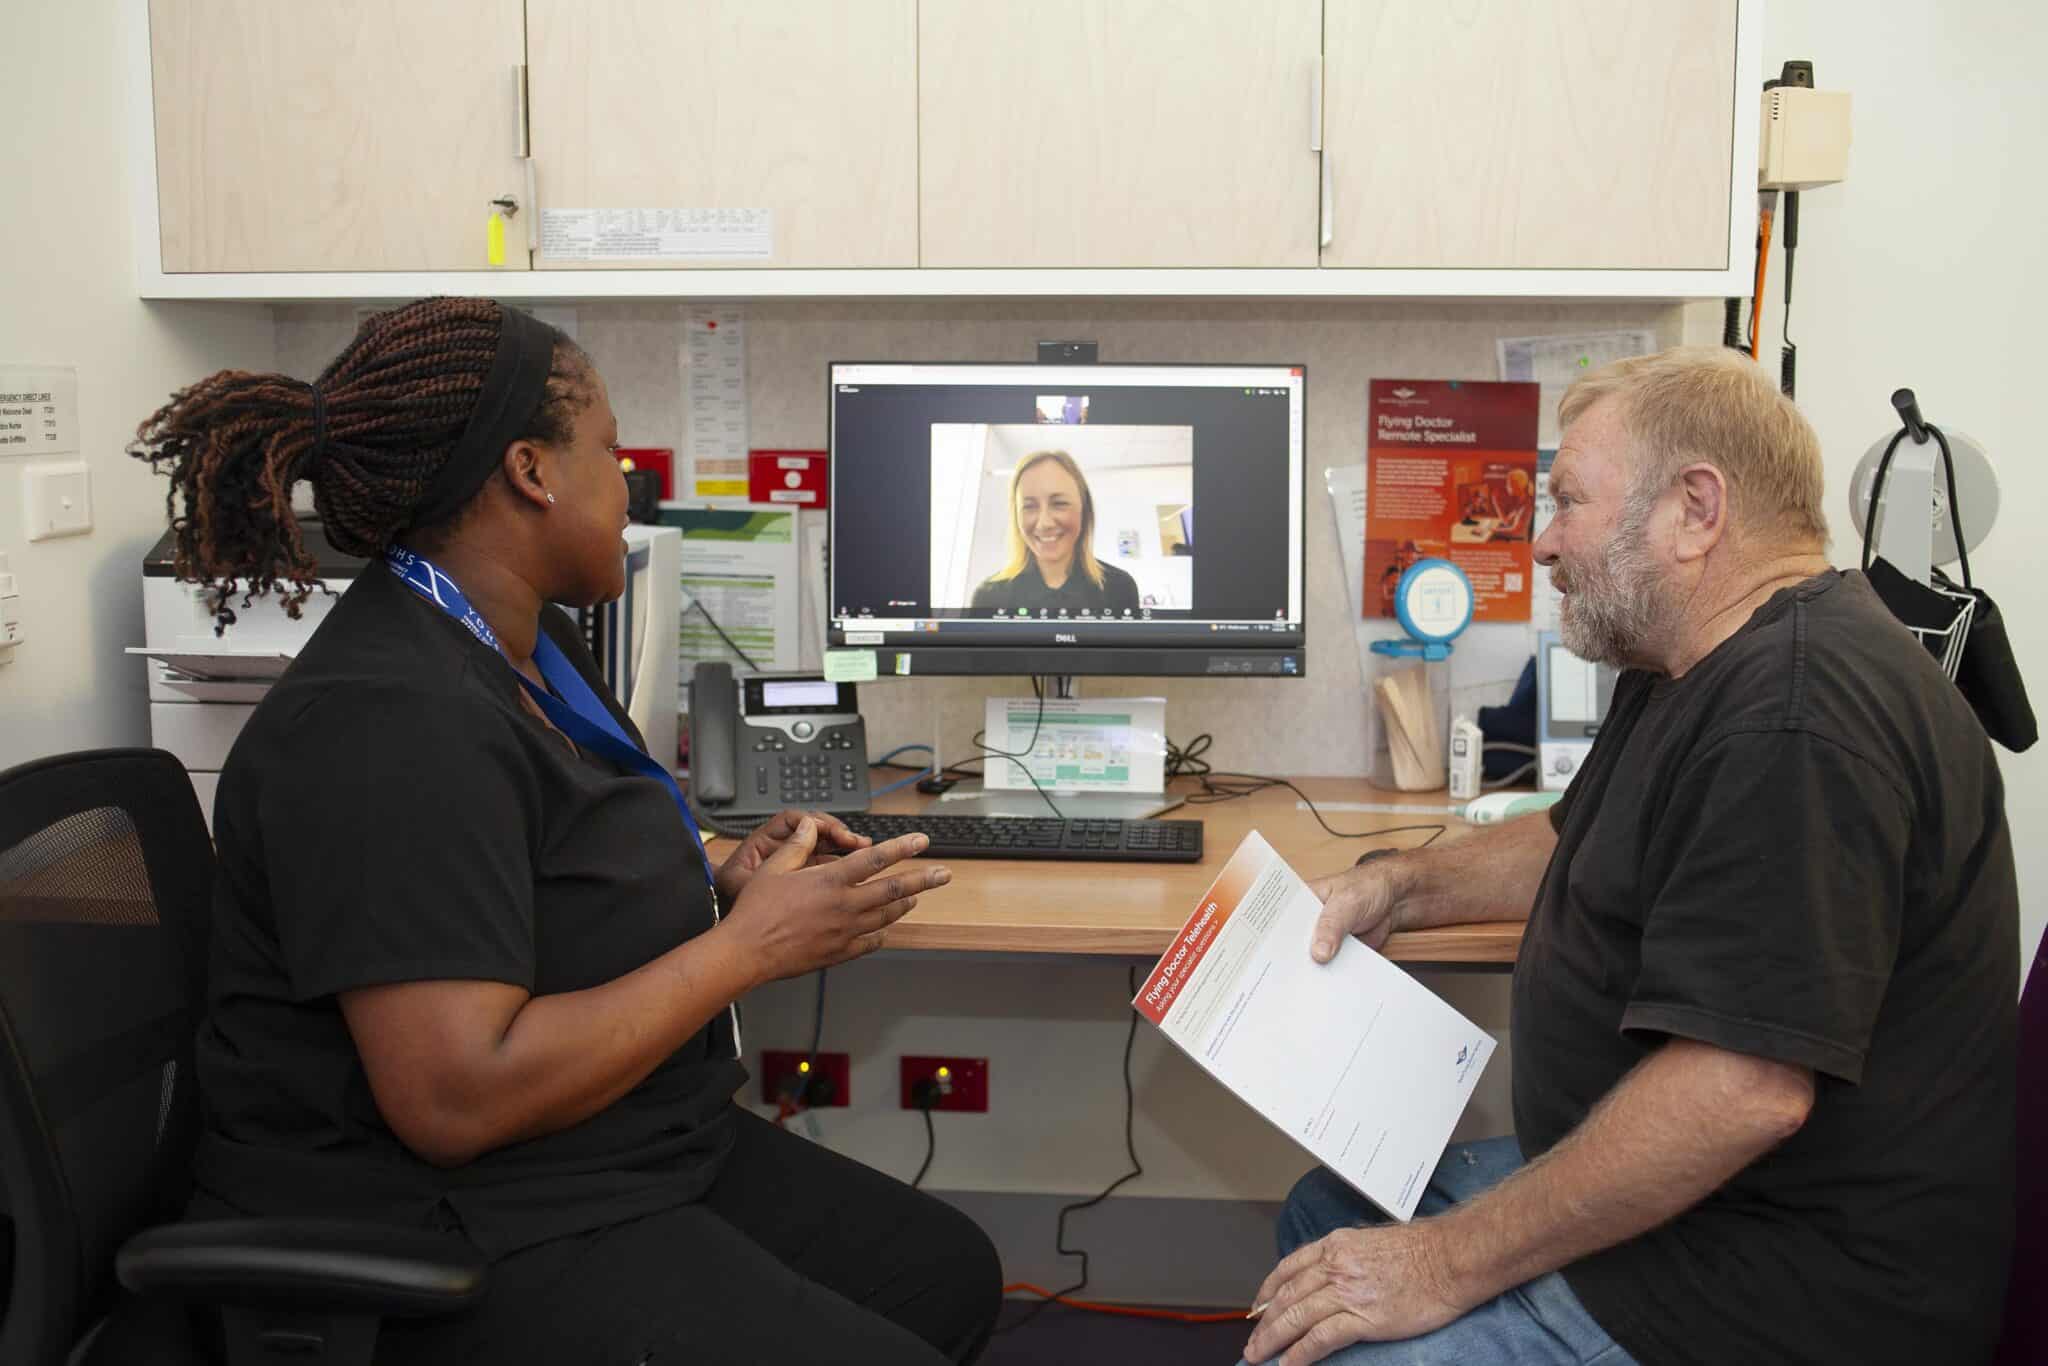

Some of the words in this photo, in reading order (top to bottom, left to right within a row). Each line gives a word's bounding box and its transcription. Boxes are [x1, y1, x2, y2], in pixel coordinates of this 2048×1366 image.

[1378, 415, 1412, 429] Flying
[1415, 415, 1454, 428] Doctor
[1378, 430, 1422, 441] Remote
[1423, 431, 1477, 444] Specialist
[1055, 634, 1077, 642] DELL
[1145, 975, 1169, 1004] Flying
[1162, 944, 1188, 977] Doctor
[1183, 901, 1217, 945] Telehealth
[1167, 977, 1181, 994] your
